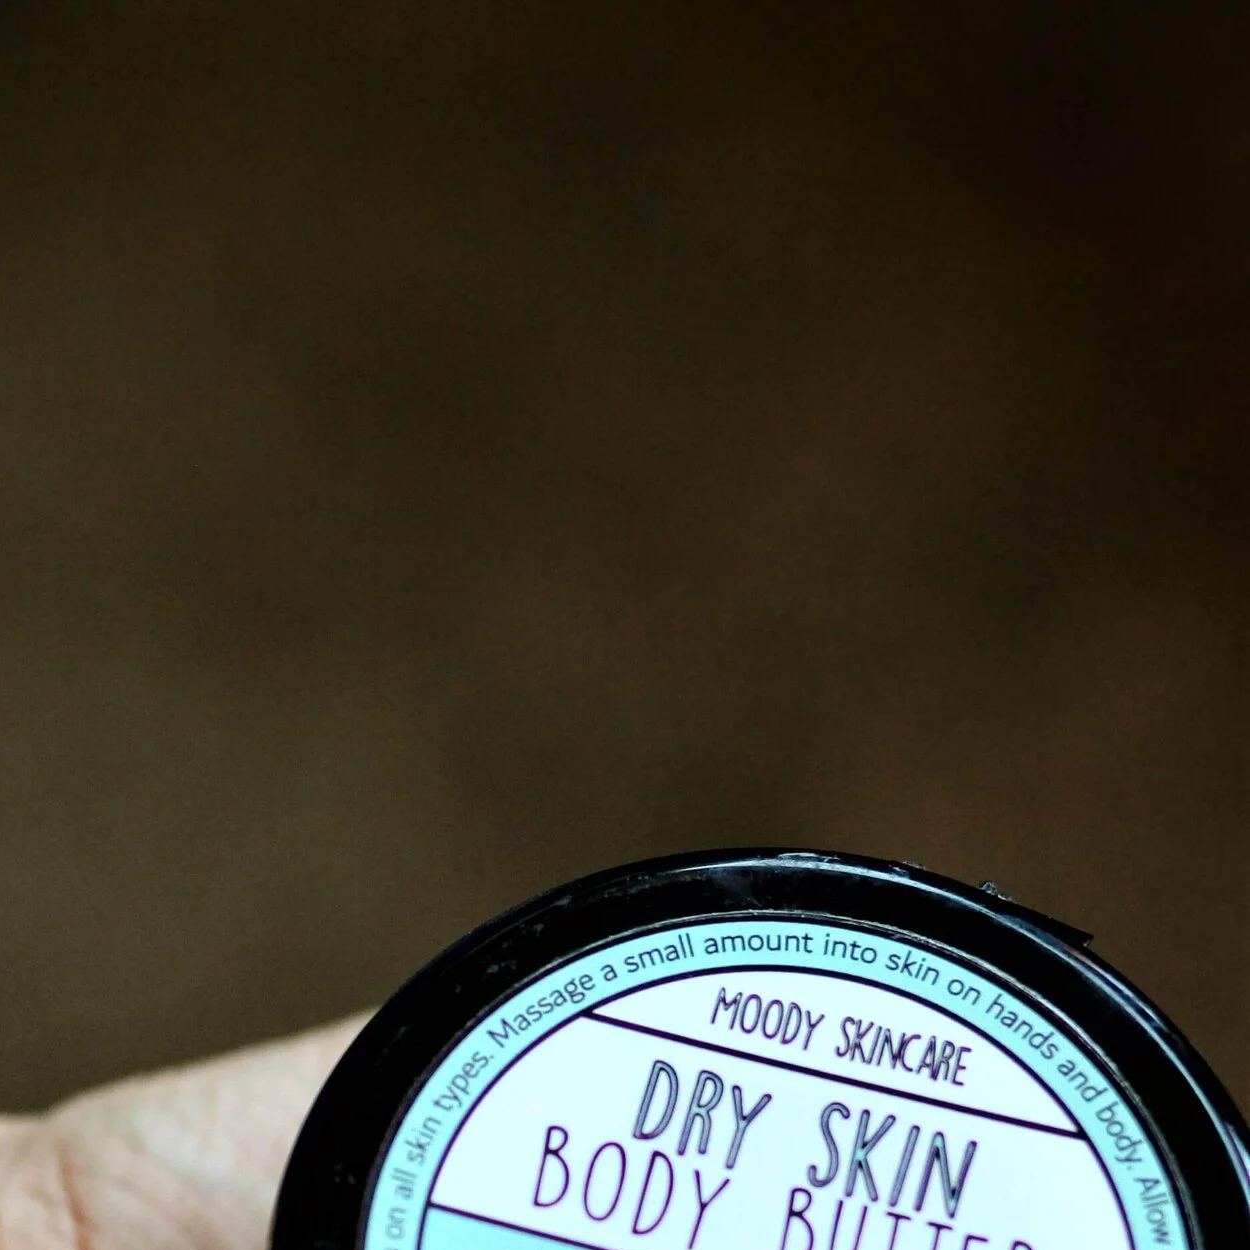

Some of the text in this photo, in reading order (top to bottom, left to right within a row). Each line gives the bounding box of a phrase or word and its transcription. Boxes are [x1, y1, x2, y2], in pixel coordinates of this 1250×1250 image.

[622, 932, 695, 973] small
[703, 932, 814, 955] amount
[822, 932, 877, 964] into
[599, 963, 618, 982] a
[883, 949, 940, 986] skin
[485, 973, 596, 1048] Massage
[946, 978, 981, 1006] on
[710, 987, 972, 1086] MOODY SKINCARE
[985, 994, 1059, 1060] hands
[434, 1050, 493, 1111] types.
[1056, 1058, 1108, 1103] and
[406, 1116, 442, 1166] skin
[632, 1060, 977, 1219] DRY SKIN
[1094, 1100, 1143, 1170] body.
[391, 1167, 417, 1201] all
[533, 1126, 730, 1250] BODY
[385, 1207, 407, 1240] on
[1135, 1176, 1171, 1245] Allow
